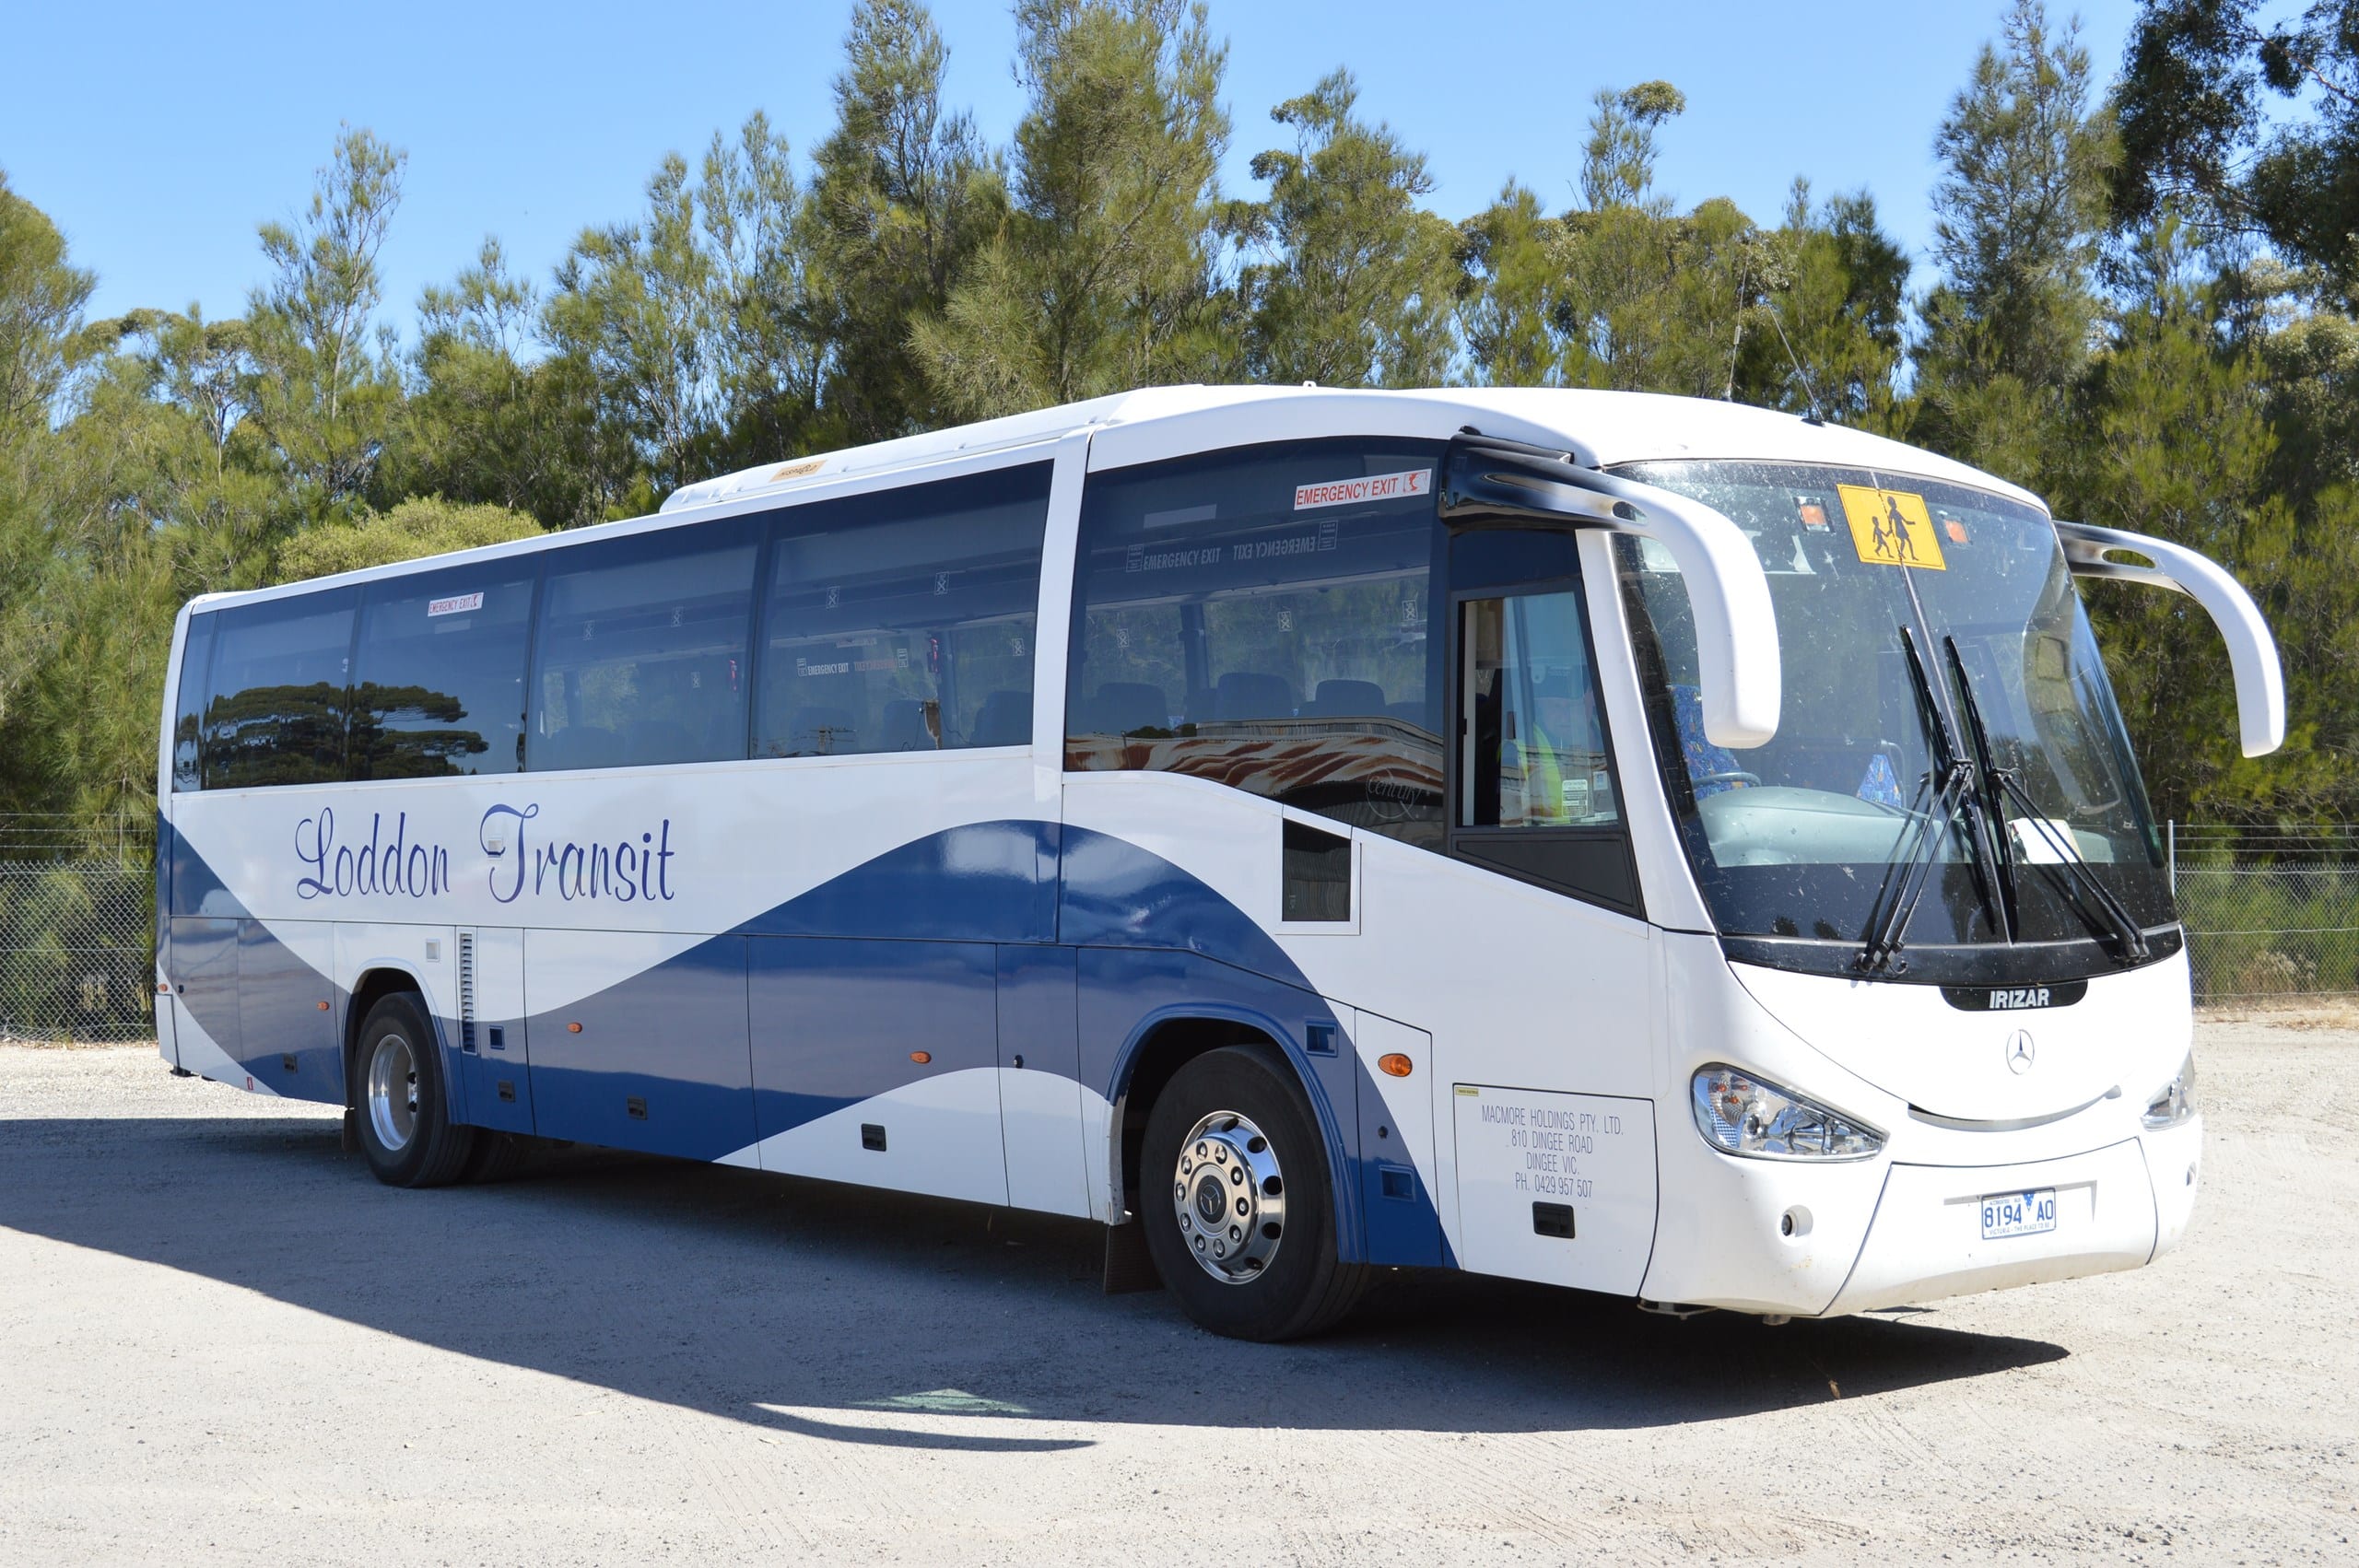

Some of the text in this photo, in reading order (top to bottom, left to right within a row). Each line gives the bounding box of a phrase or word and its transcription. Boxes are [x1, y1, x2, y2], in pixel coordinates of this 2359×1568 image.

[1296, 476, 1400, 506] EMERGENCY EXIT
[1143, 549, 1199, 571] EMERGENCY
[1201, 547, 1222, 565] EXIT
[808, 662, 838, 675] EMERGENCY
[839, 661, 849, 673] EXIT
[295, 802, 675, 904] Loddon Transit
[1989, 989, 2049, 1009] IRIZAR
[1481, 1105, 1624, 1136] MACMORE HOLDINGS PTY. LTD.
[1511, 1129, 1593, 1154] 810 DINGEE ROAD
[1526, 1152, 1579, 1176] DINGEE VIC.
[1515, 1171, 1593, 1199] PH. 0429 957 507
[1984, 1203, 2022, 1227] 8194
